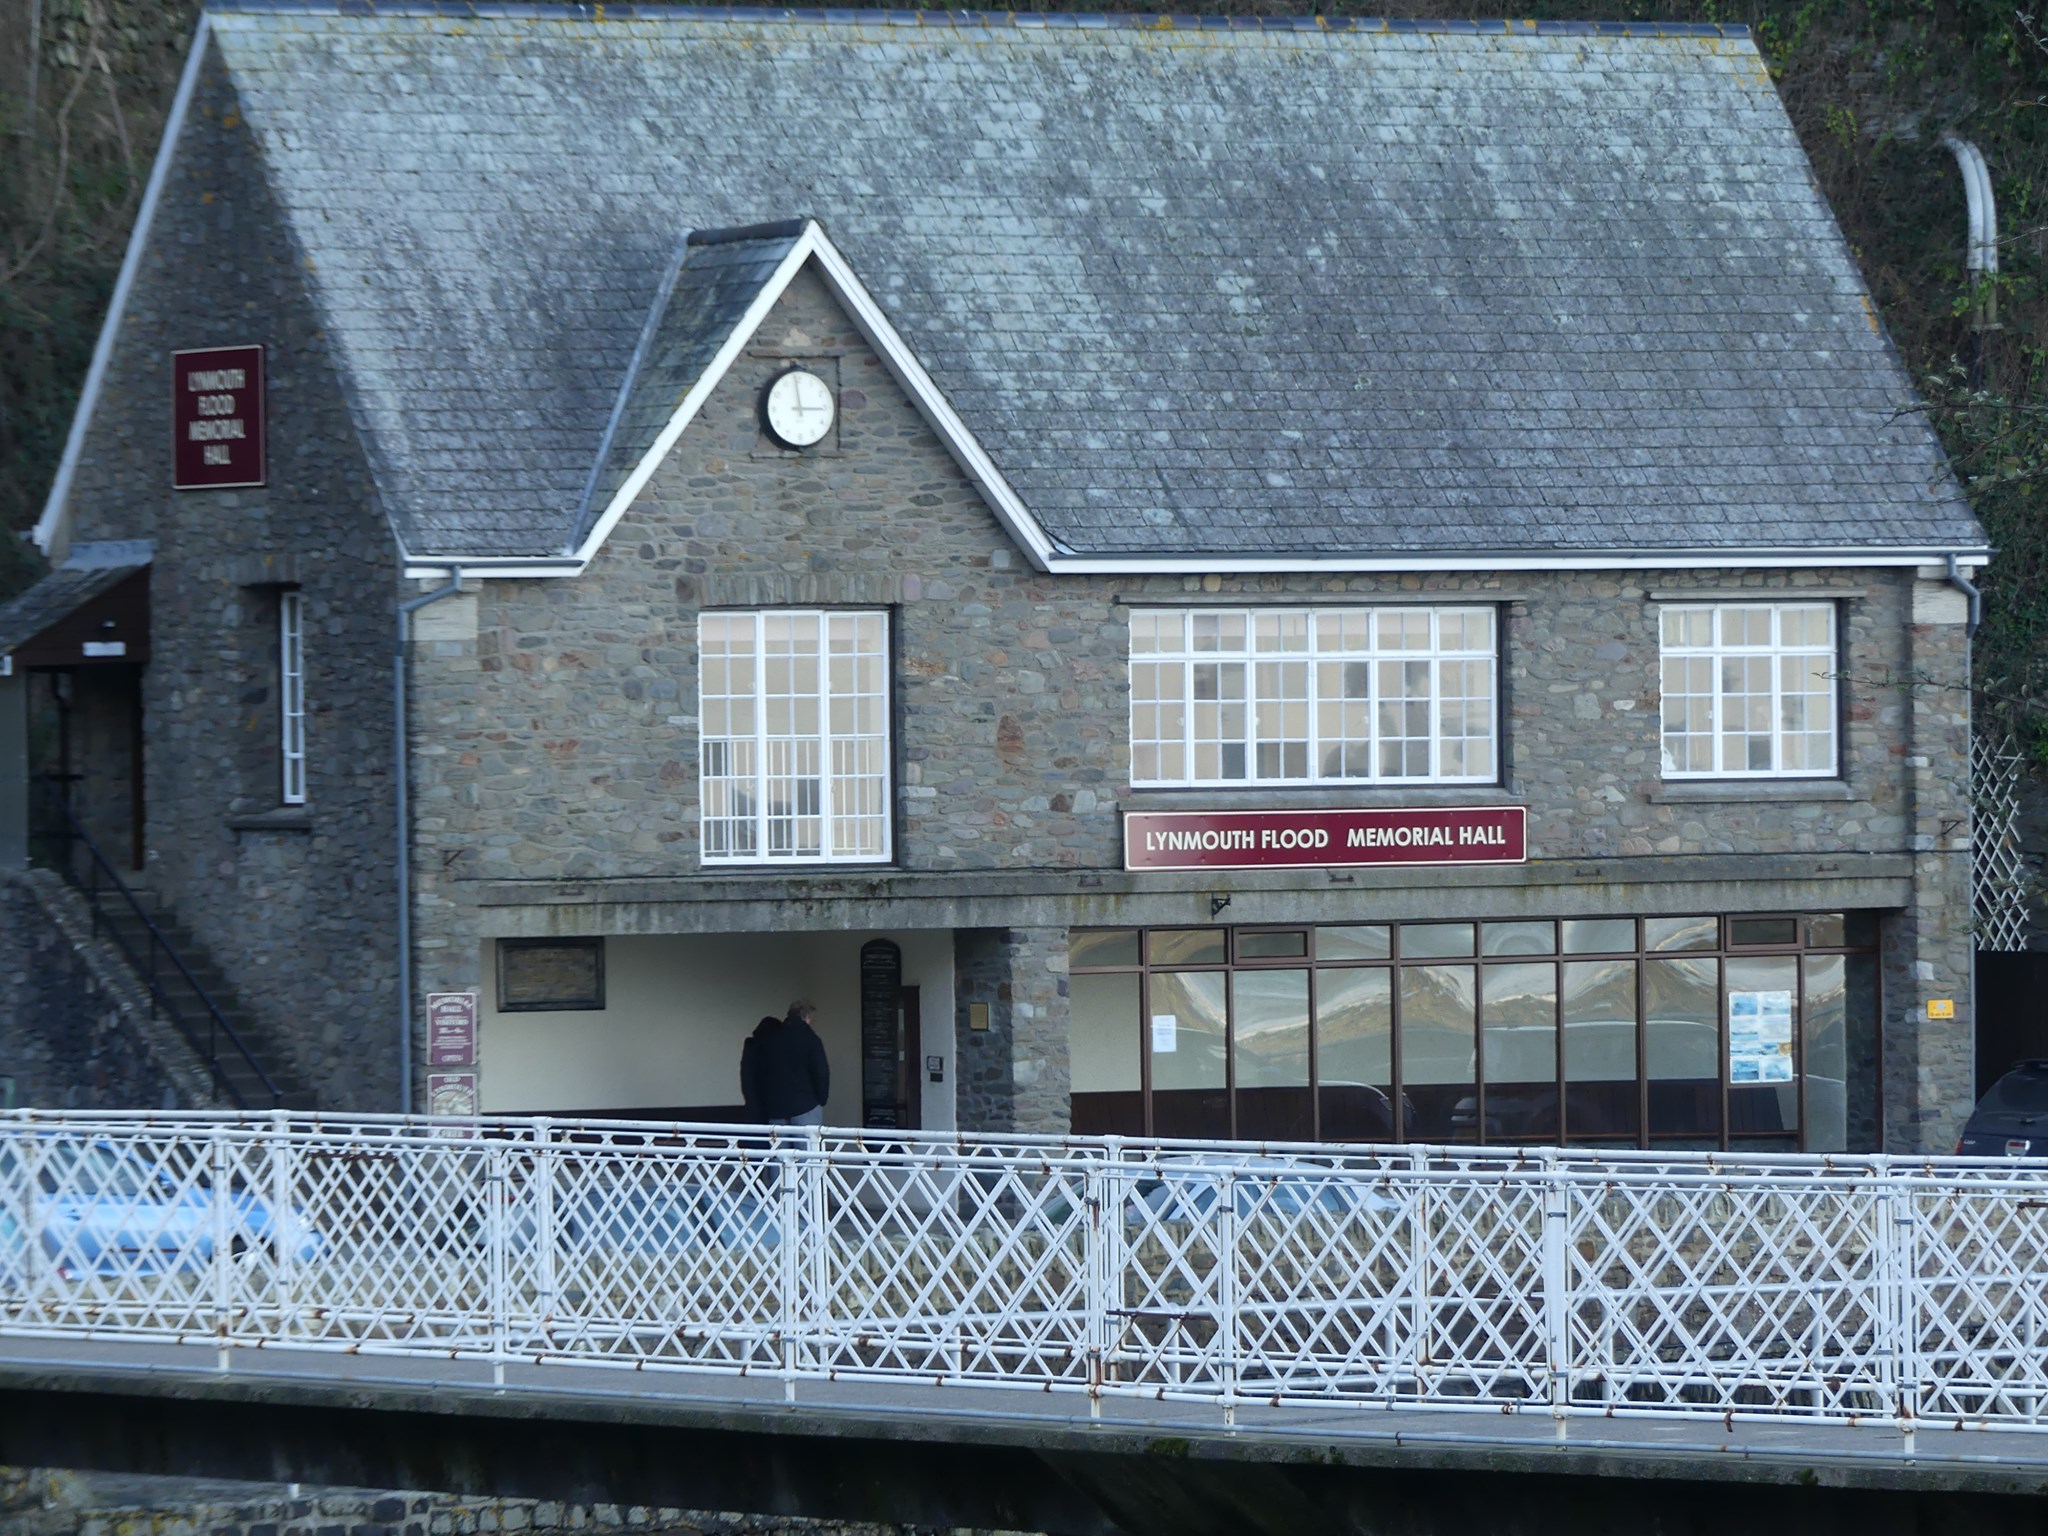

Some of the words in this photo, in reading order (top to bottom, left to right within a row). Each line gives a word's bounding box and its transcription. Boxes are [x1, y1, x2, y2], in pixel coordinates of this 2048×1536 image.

[1146, 830, 1255, 852] LYNMOUTH
[1261, 828, 1329, 850] FLOOD
[1346, 826, 1454, 848] MEMORIAL
[1459, 825, 1506, 846] HALL
